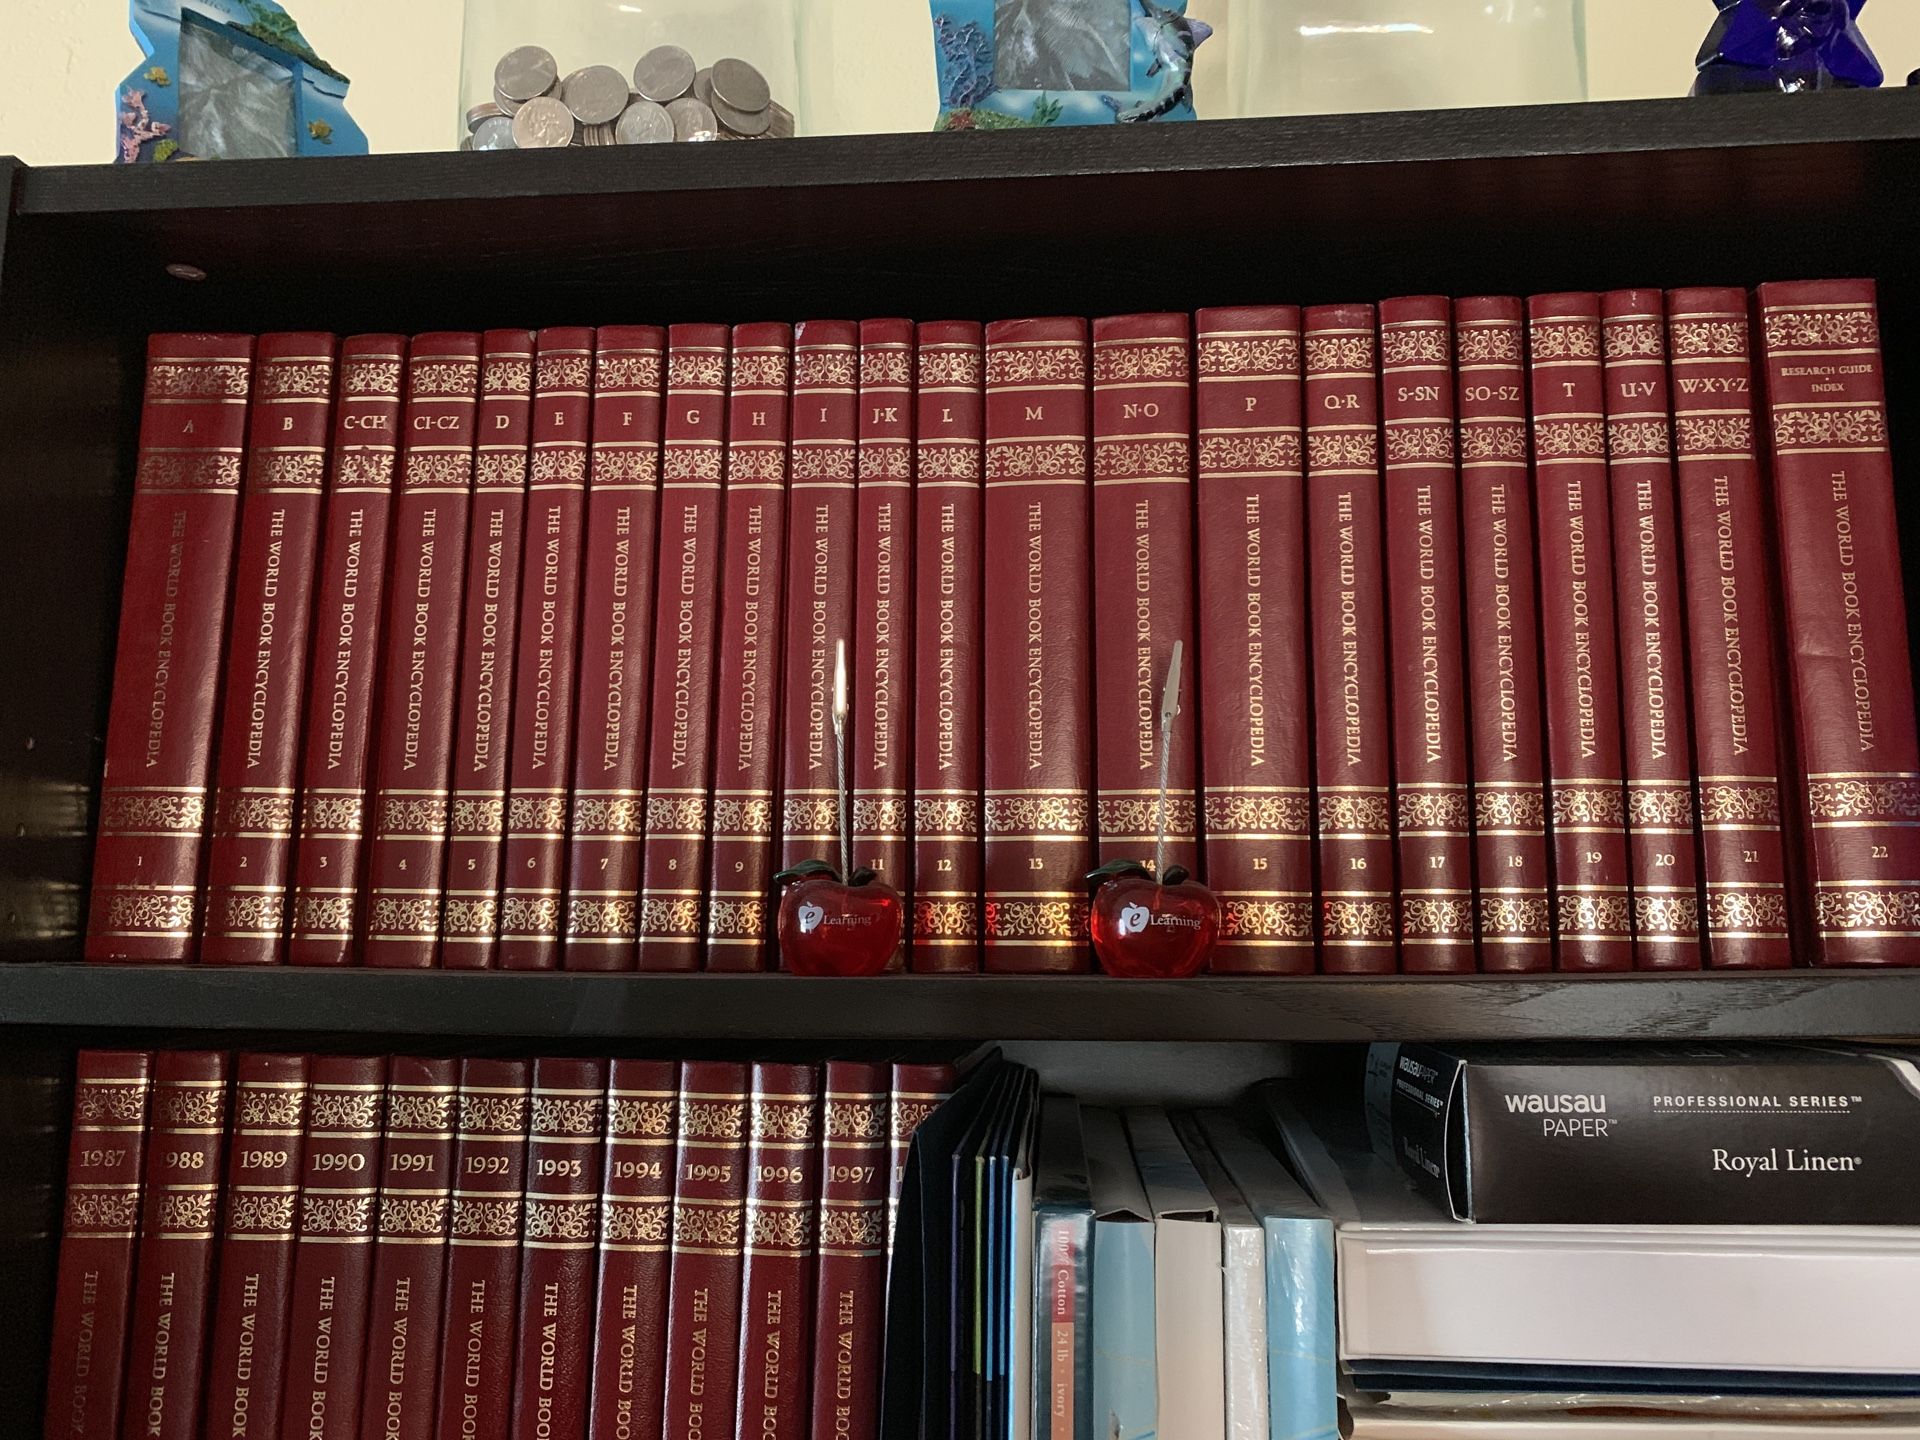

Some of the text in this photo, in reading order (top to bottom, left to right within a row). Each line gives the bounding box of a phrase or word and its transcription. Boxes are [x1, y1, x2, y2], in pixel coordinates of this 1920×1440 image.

[1780, 364, 1874, 377] RESEARCH GUIDE
[1562, 382, 1576, 398] T
[1811, 382, 1845, 393] INDEX
[1245, 397, 1257, 412] P
[495, 414, 510, 429] D
[554, 411, 565, 426] E
[622, 411, 633, 426] F
[686, 409, 700, 425] G
[751, 411, 766, 426] H
[820, 407, 828, 423] I
[942, 408, 953, 423] L
[1024, 406, 1044, 421] M
[182, 419, 194, 434] A
[282, 416, 293, 431] B
[1568, 481, 1595, 758] THE WORLD BOOK ENCYCLOPEDIA
[1637, 480, 1666, 759] THE WORLD BOOK ENCYCLOPEDIA
[1832, 471, 1874, 752] THE WORLD BOOK ENCYCLOPEDIA
[1247, 494, 1264, 766] THE WORLD BOOK ENCYCLOPEDIA
[1338, 492, 1361, 766] THE WORLD BOOK ENCYCLOPEDIA
[1418, 485, 1441, 763] THE WORLD BOOK ENCYCLOPEDIA
[1491, 484, 1517, 761] THE WORLD BOOK ENCYCLOPEDIA
[247, 509, 285, 768] THE WORLD BOOK ENCYCLOPEDIA
[328, 509, 363, 769] THE WORLD BOOK ENCYCLOPEDIA
[403, 509, 436, 770] THE WORLD BOOK ENCYCLOPEDIA
[474, 509, 503, 771] THE WORLD BOOK ENCYCLOPEDIA
[532, 506, 560, 769] THE WORLD BOOK ENCYCLOPEDIA
[672, 505, 697, 769] THE WORLD BOOK ENCYCLOPEDIA
[738, 506, 761, 771] THE WORLD BOOK ENCYCLOPEDIA
[874, 503, 891, 770] THE WORLD BOOK ENCYCLOPEDIA
[939, 504, 954, 770] THE WORLD BOOK ENCYCLOPEDIA
[1585, 851, 1603, 864] 19
[1655, 853, 1676, 867] 20
[1743, 850, 1759, 863] 21
[1871, 845, 1889, 859] 22
[137, 855, 143, 867] 1
[239, 856, 248, 868] 2
[319, 856, 328, 868] 3
[398, 858, 408, 871] 4
[467, 858, 476, 871] 5
[527, 857, 536, 869] 6
[600, 858, 609, 870] 7
[668, 858, 678, 871] 8
[734, 861, 744, 873] 9
[871, 858, 885, 871] 11
[937, 858, 953, 872] 12
[1028, 857, 1044, 870] 13
[1252, 857, 1268, 870] 15
[1349, 857, 1367, 870] 16
[1429, 855, 1446, 869] 17
[1507, 855, 1523, 868] 18
[1504, 1094, 1607, 1114] wausau
[1653, 1095, 1782, 1107] PROFESSIONAL
[79, 1149, 127, 1168] 1987
[240, 1150, 288, 1169] 1989
[311, 1153, 366, 1172] 1990
[389, 1153, 435, 1172] 1991
[465, 1156, 510, 1175] 1992
[1712, 1147, 1779, 1178] Royal
[536, 1158, 582, 1178] 1993
[613, 1160, 663, 1180] 1994
[684, 1163, 732, 1183] 1995
[755, 1165, 804, 1184] 1996
[828, 1165, 876, 1184] 1997
[320, 1277, 335, 1310] THE
[395, 1277, 410, 1311] THE
[1057, 1269, 1070, 1315] Cotton
[1057, 1330, 1069, 1345] 24
[149, 1273, 174, 1437] THE WORLD BOOK
[233, 1274, 259, 1437] THE WORLD BOOK
[314, 1317, 331, 1383] WORLD
[390, 1317, 407, 1384] WORLD
[1056, 1349, 1070, 1362] lb
[1054, 1383, 1069, 1417] ivory
